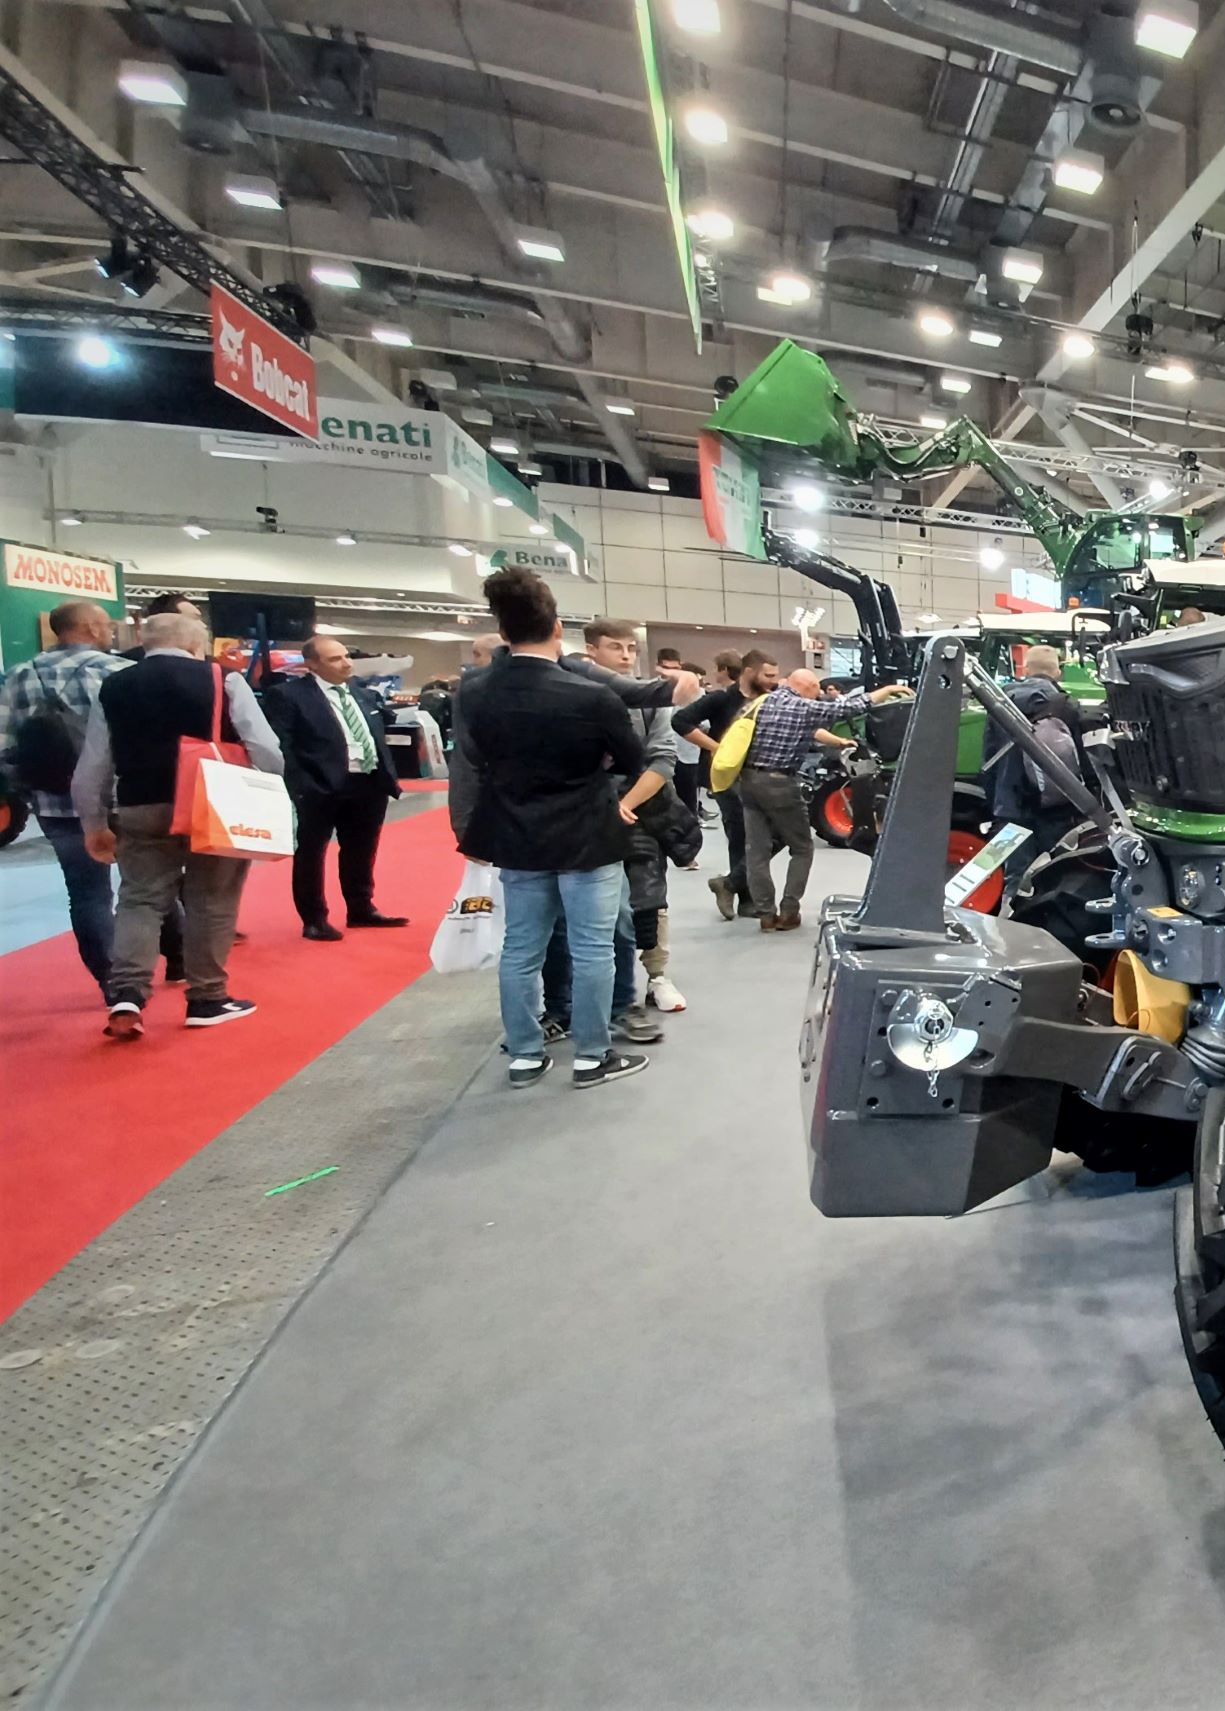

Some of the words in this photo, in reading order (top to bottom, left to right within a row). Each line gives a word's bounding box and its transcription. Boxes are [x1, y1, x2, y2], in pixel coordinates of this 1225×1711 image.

[251, 342, 310, 422] Bobcat
[321, 416, 432, 448] enati
[370, 448, 433, 461] agricole
[14, 554, 112, 593] MONOSEM
[515, 551, 568, 567] Bena
